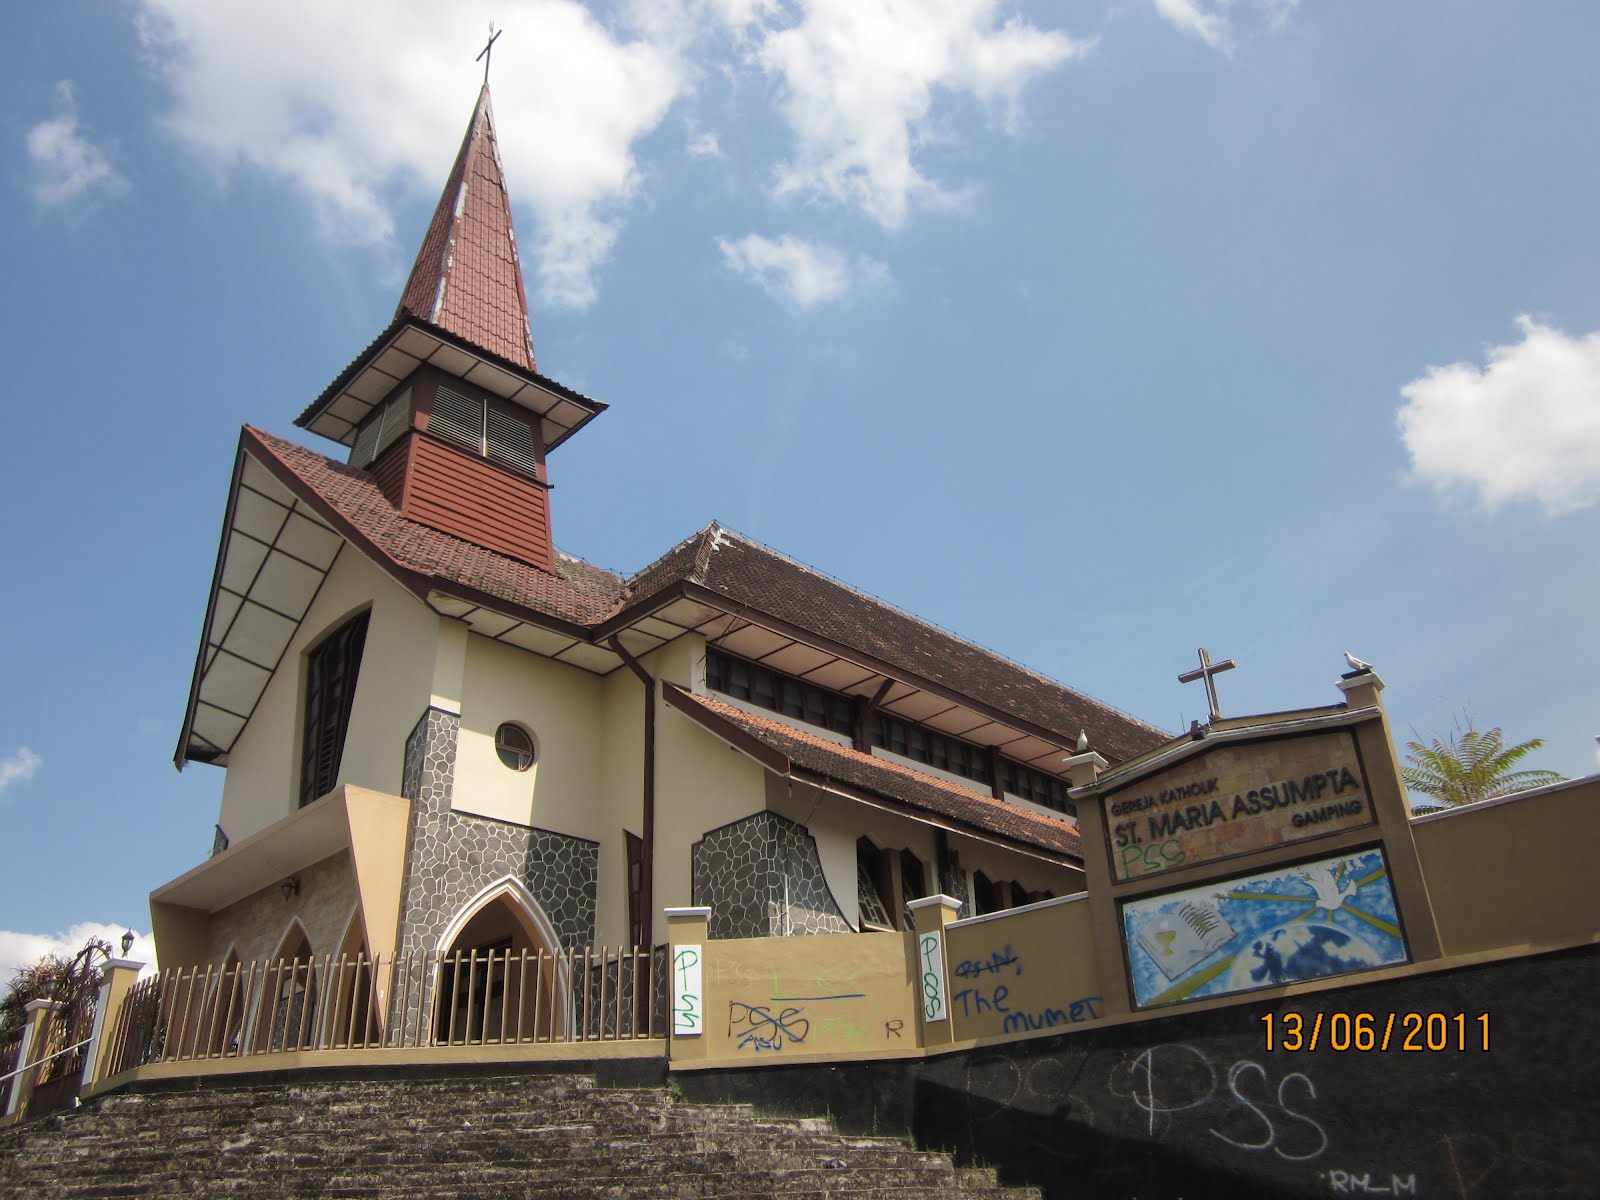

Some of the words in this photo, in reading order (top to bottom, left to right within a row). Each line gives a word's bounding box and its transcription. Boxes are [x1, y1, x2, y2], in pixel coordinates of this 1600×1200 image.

[1111, 796, 1157, 816] GEREJA
[1157, 777, 1220, 806] KATHOLIK
[1115, 820, 1142, 848] ST.
[1149, 800, 1226, 840] MARIA
[1231, 767, 1358, 819] ASSUMPTA
[1291, 800, 1363, 829] GAMPING
[1121, 839, 1187, 879] PSS
[954, 985, 1009, 1016] The
[1131, 1044, 1327, 1160] PSS
